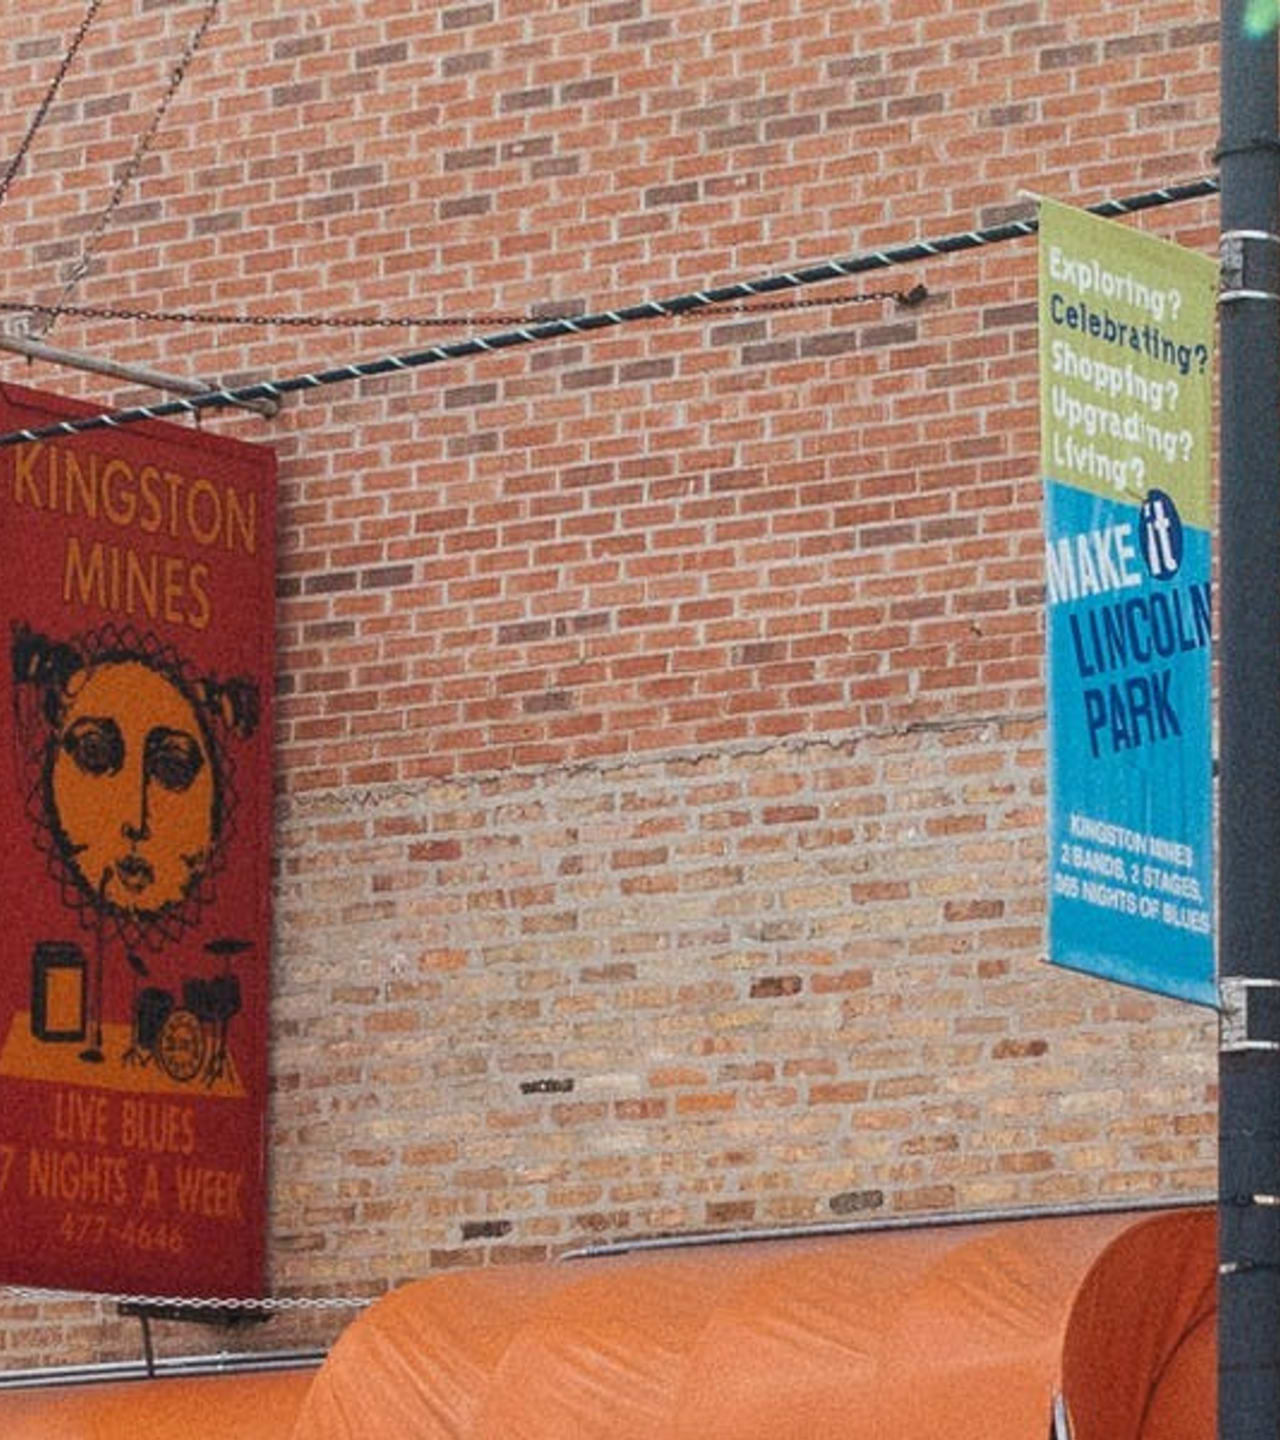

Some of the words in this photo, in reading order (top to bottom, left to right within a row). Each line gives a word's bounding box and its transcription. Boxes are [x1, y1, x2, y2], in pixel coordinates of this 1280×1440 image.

[1049, 246, 1181, 321] Exploring?
[1051, 294, 1208, 375] Celebrating?
[1052, 340, 1179, 412] Shopping?
[1052, 384, 1194, 462] Upgrading?
[1052, 431, 1145, 490] Living?
[15, 442, 258, 556] KINGSTON
[63, 536, 209, 629] MINES
[1046, 522, 1142, 605] MAKE
[1144, 500, 1178, 577] it
[1070, 581, 1213, 679] LINCOLN
[1084, 667, 1182, 760] PARK
[1139, 894, 1160, 920] OF
[54, 1091, 108, 1146] LIVE
[122, 1099, 196, 1153] BLUES
[28, 1149, 128, 1206] NIGHTS
[141, 1162, 161, 1210] A
[176, 1164, 243, 1219] WEEK
